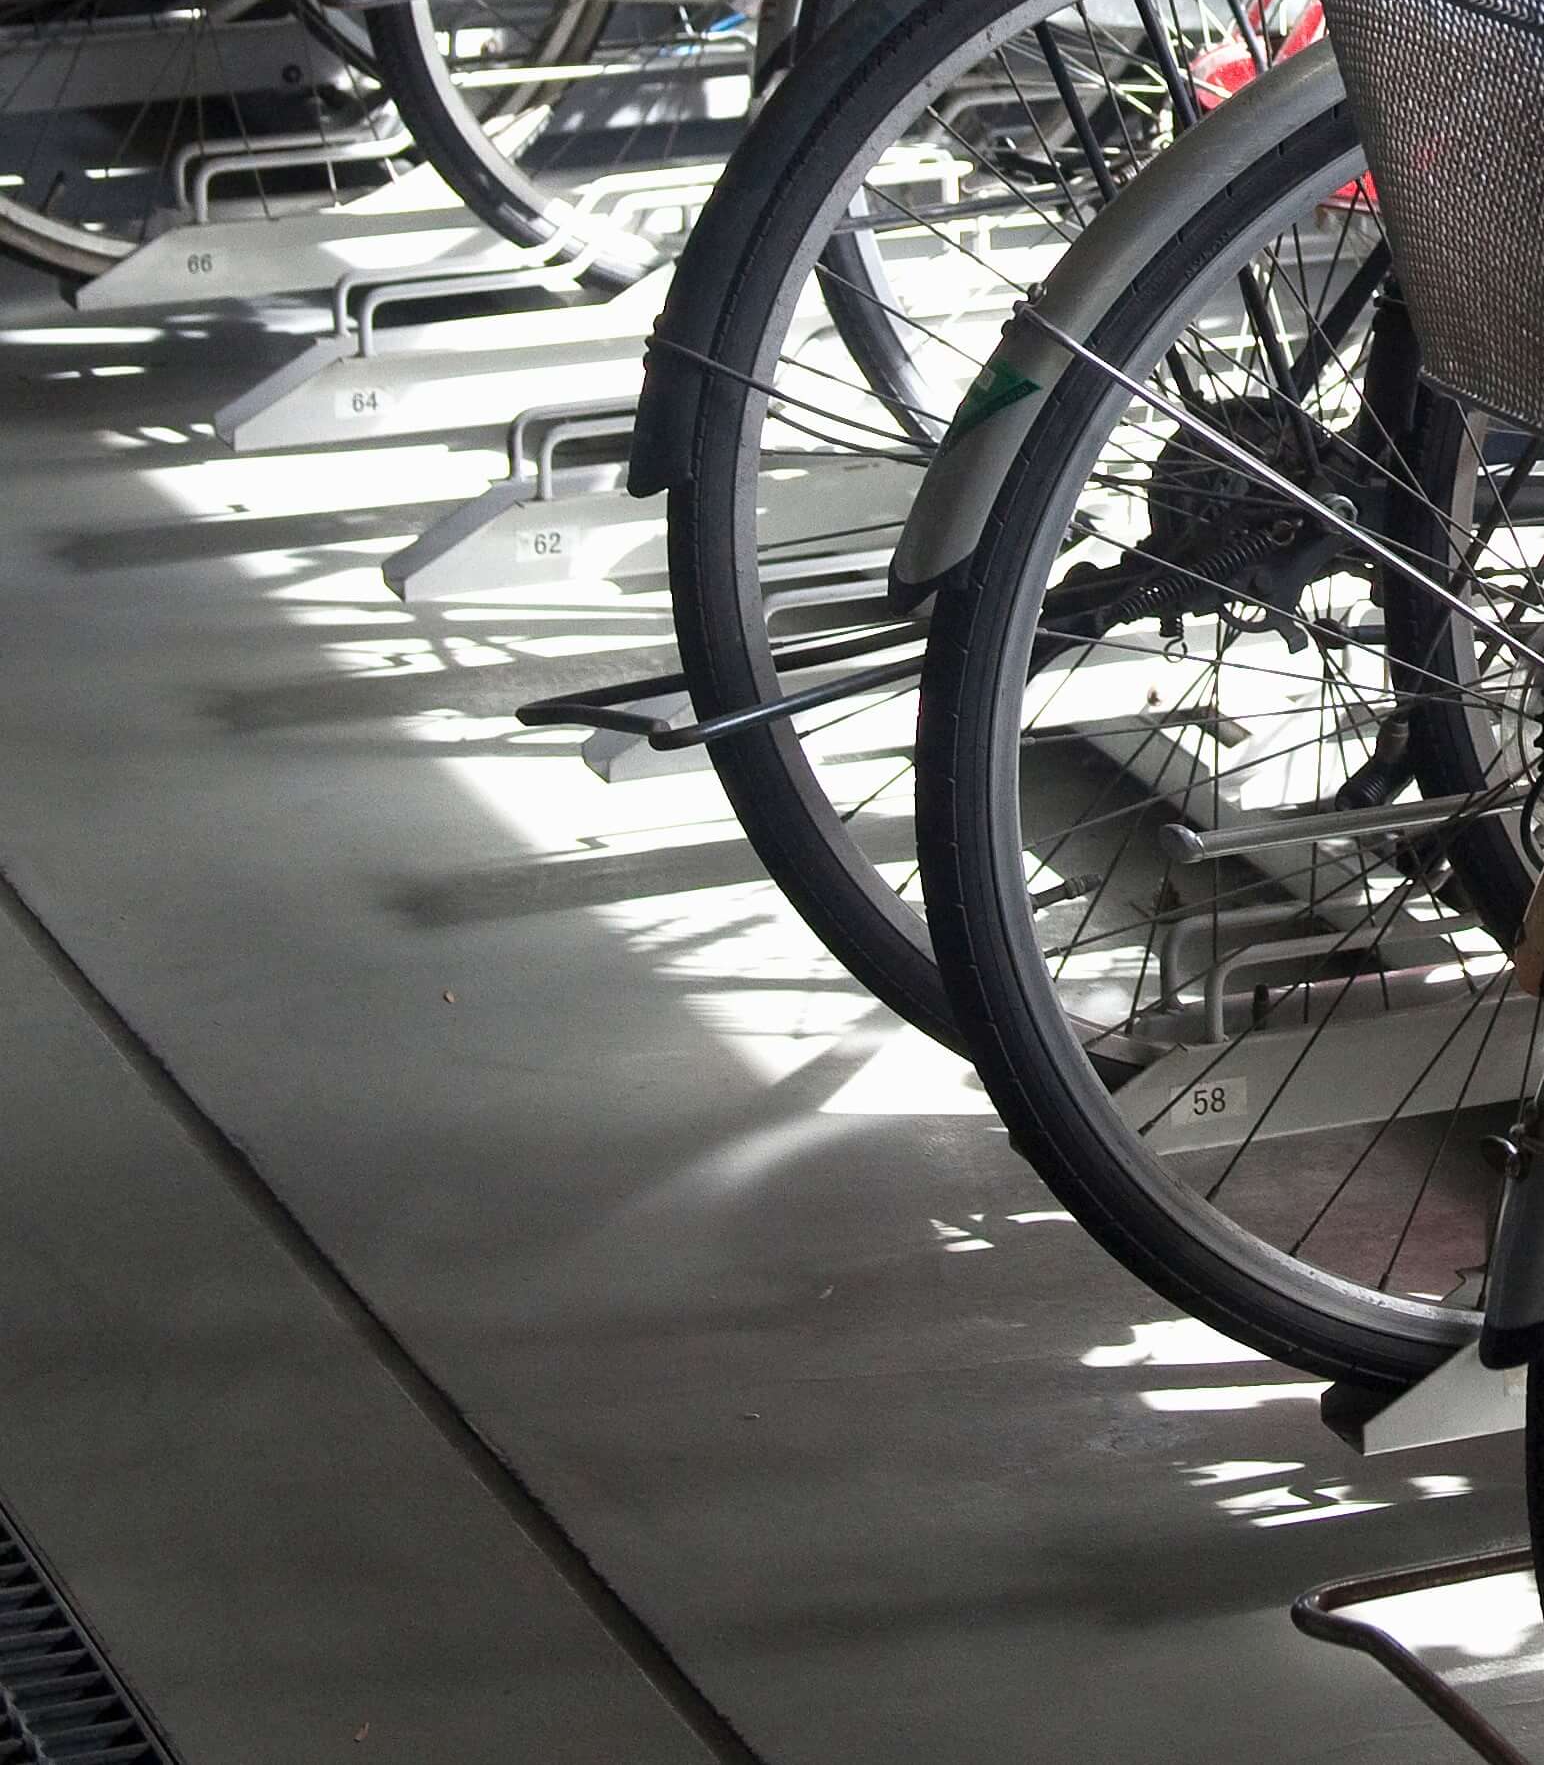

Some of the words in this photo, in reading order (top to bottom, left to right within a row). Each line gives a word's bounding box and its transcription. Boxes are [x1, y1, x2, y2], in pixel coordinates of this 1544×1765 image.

[187, 253, 213, 274] 66
[352, 391, 379, 412] 64
[534, 531, 562, 555] 62
[1193, 1087, 1226, 1116] 58
